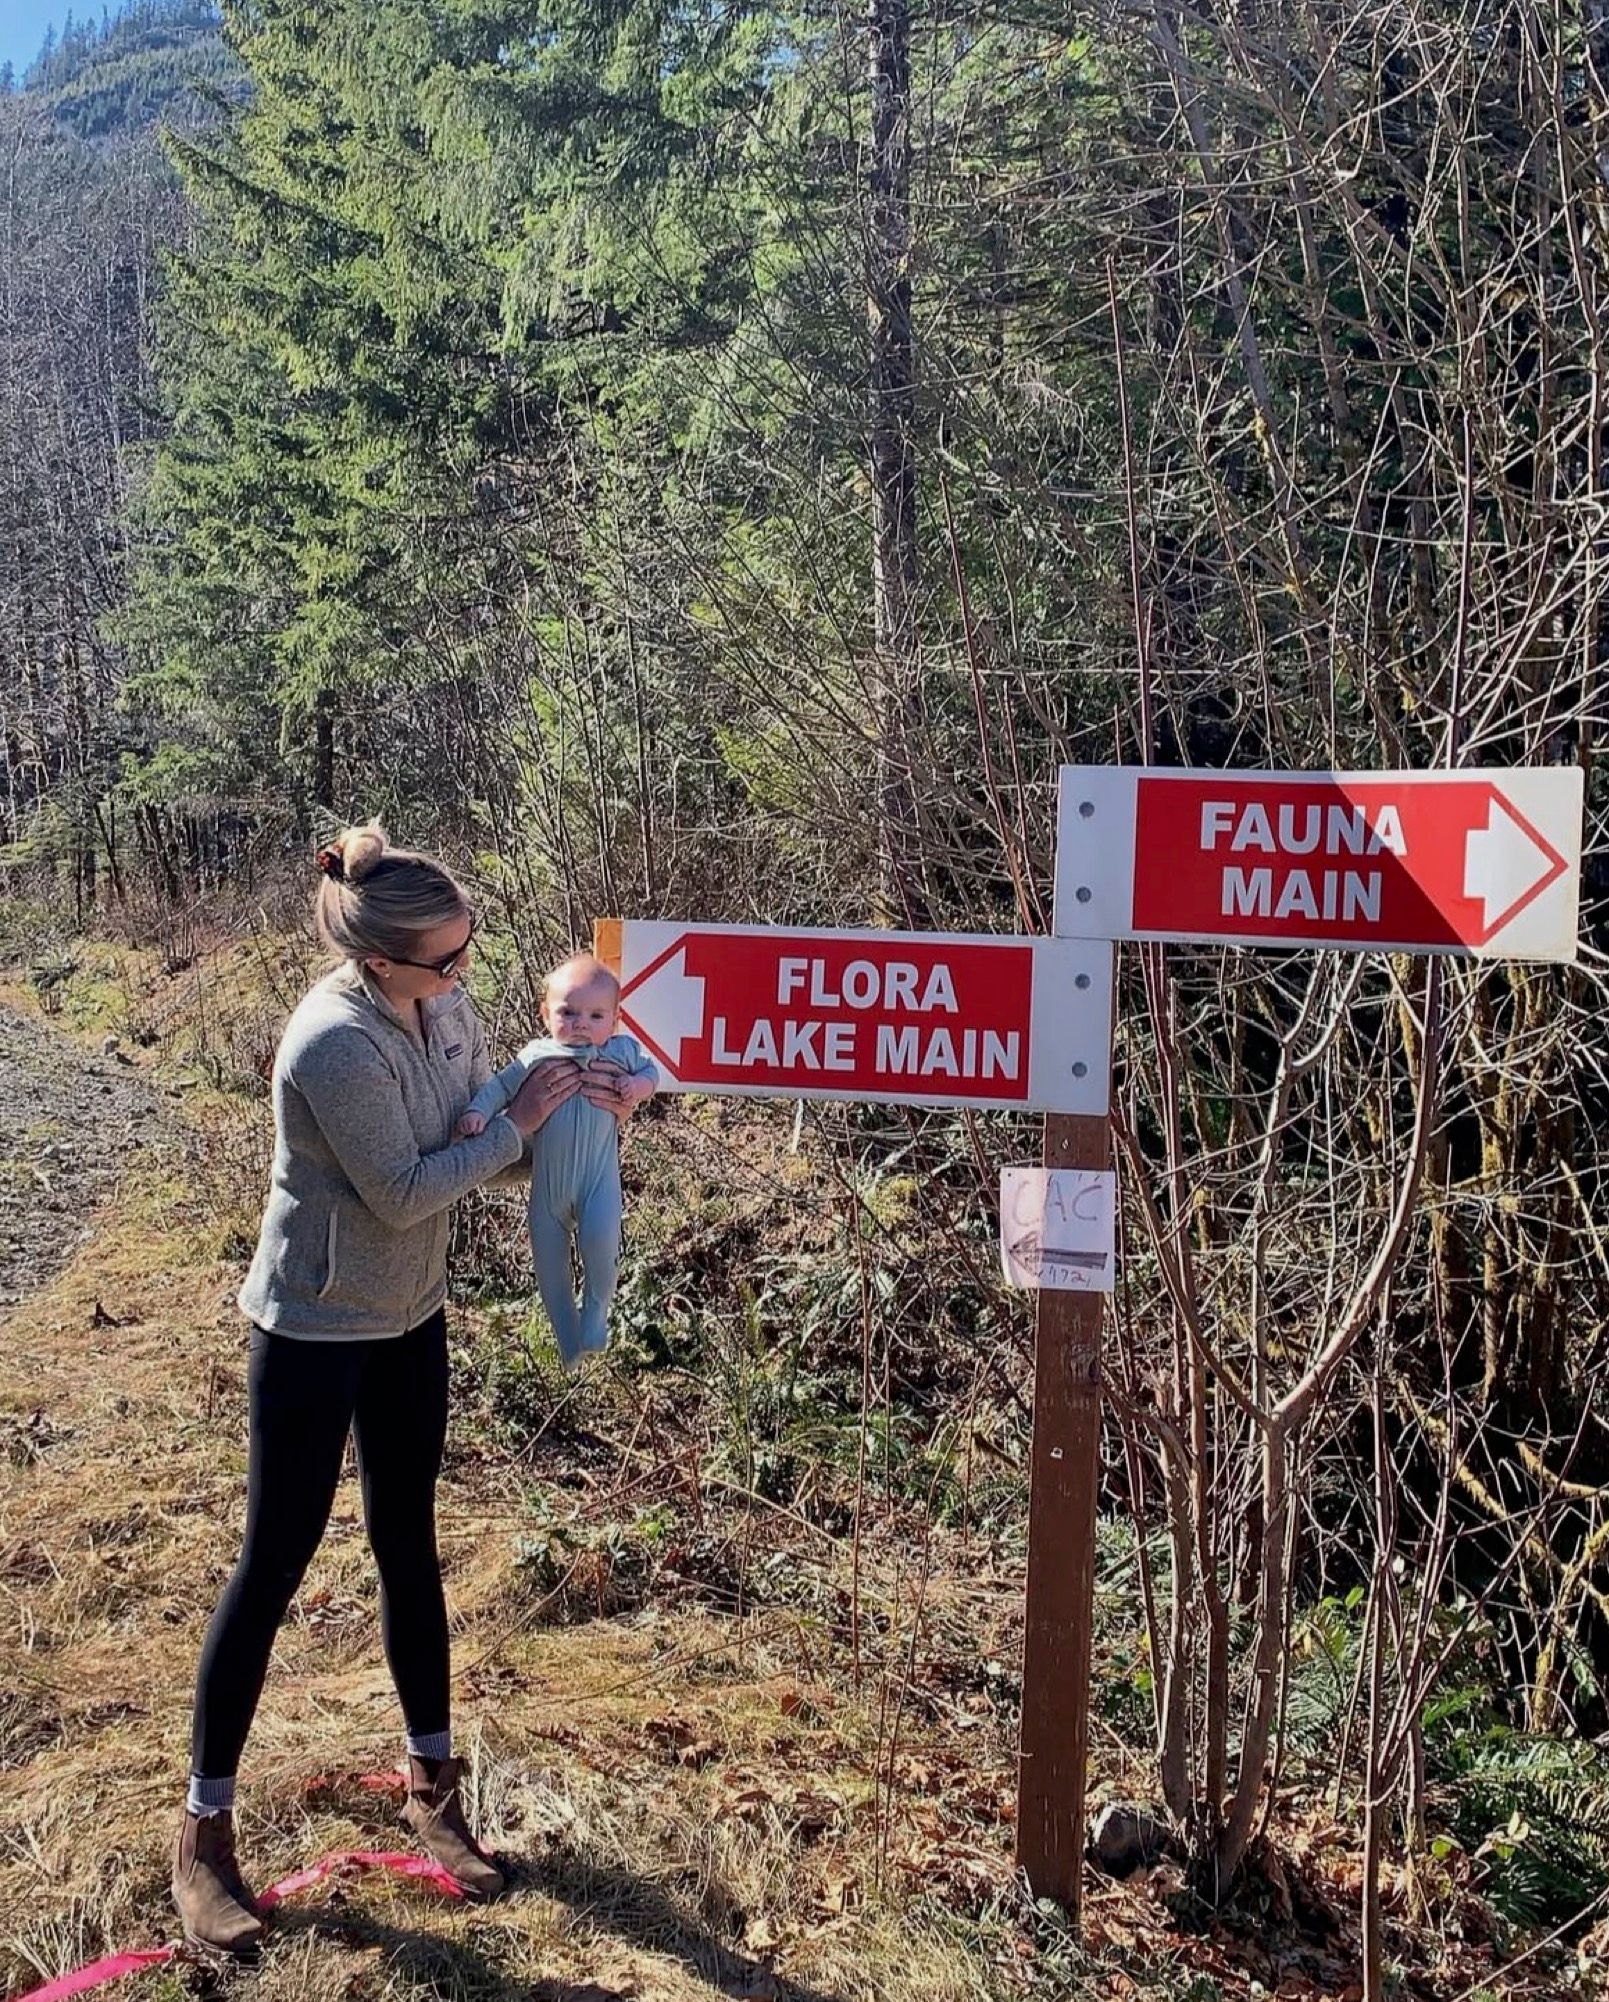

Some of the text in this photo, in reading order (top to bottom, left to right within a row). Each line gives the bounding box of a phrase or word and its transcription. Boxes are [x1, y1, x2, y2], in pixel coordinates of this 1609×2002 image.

[1200, 801, 1407, 856] FAUNA
[1220, 866, 1382, 921] MAIN
[777, 957, 958, 1013] FLORA
[711, 1016, 1020, 1081] LAKE MAIN
[1012, 1174, 1103, 1227] CAC
